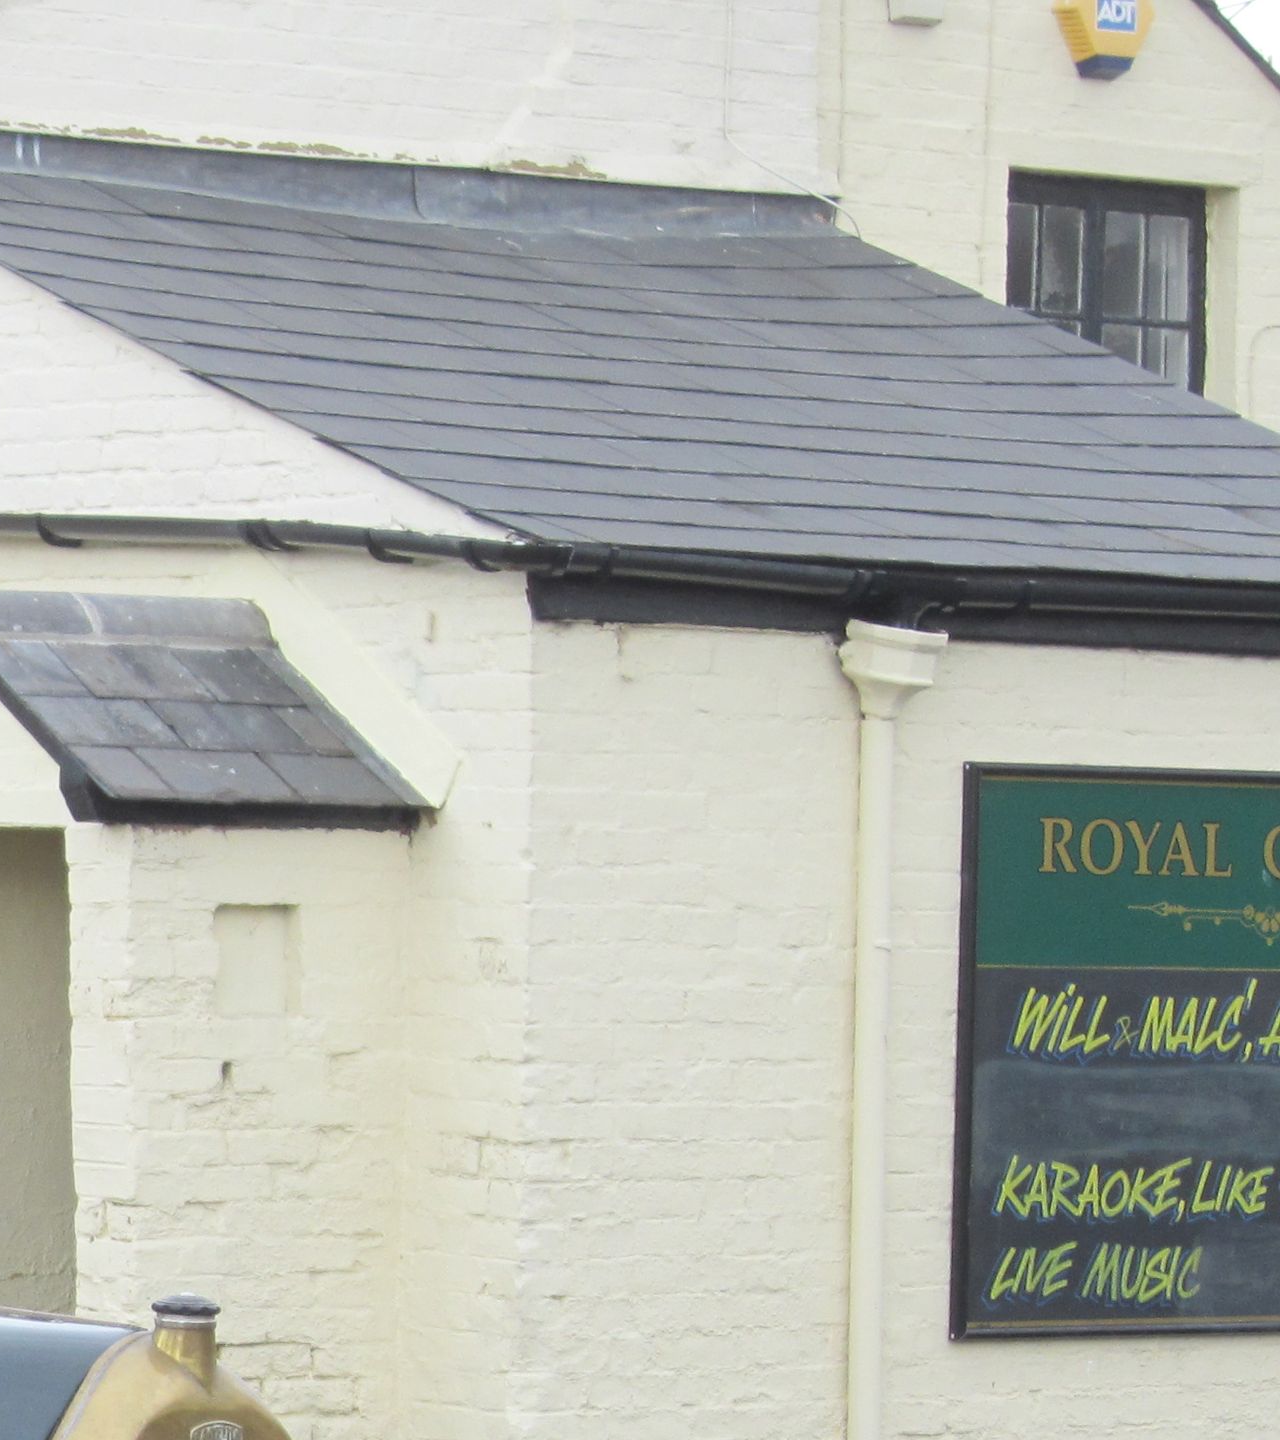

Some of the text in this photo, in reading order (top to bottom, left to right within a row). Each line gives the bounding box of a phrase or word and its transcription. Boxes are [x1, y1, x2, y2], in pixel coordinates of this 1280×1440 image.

[1097, 0, 1137, 24] ADT
[1038, 816, 1233, 878] ROYAL
[996, 1155, 1275, 1222] KARAOKE, LIKE
[990, 1241, 1203, 1303] LIVE MUSIC
